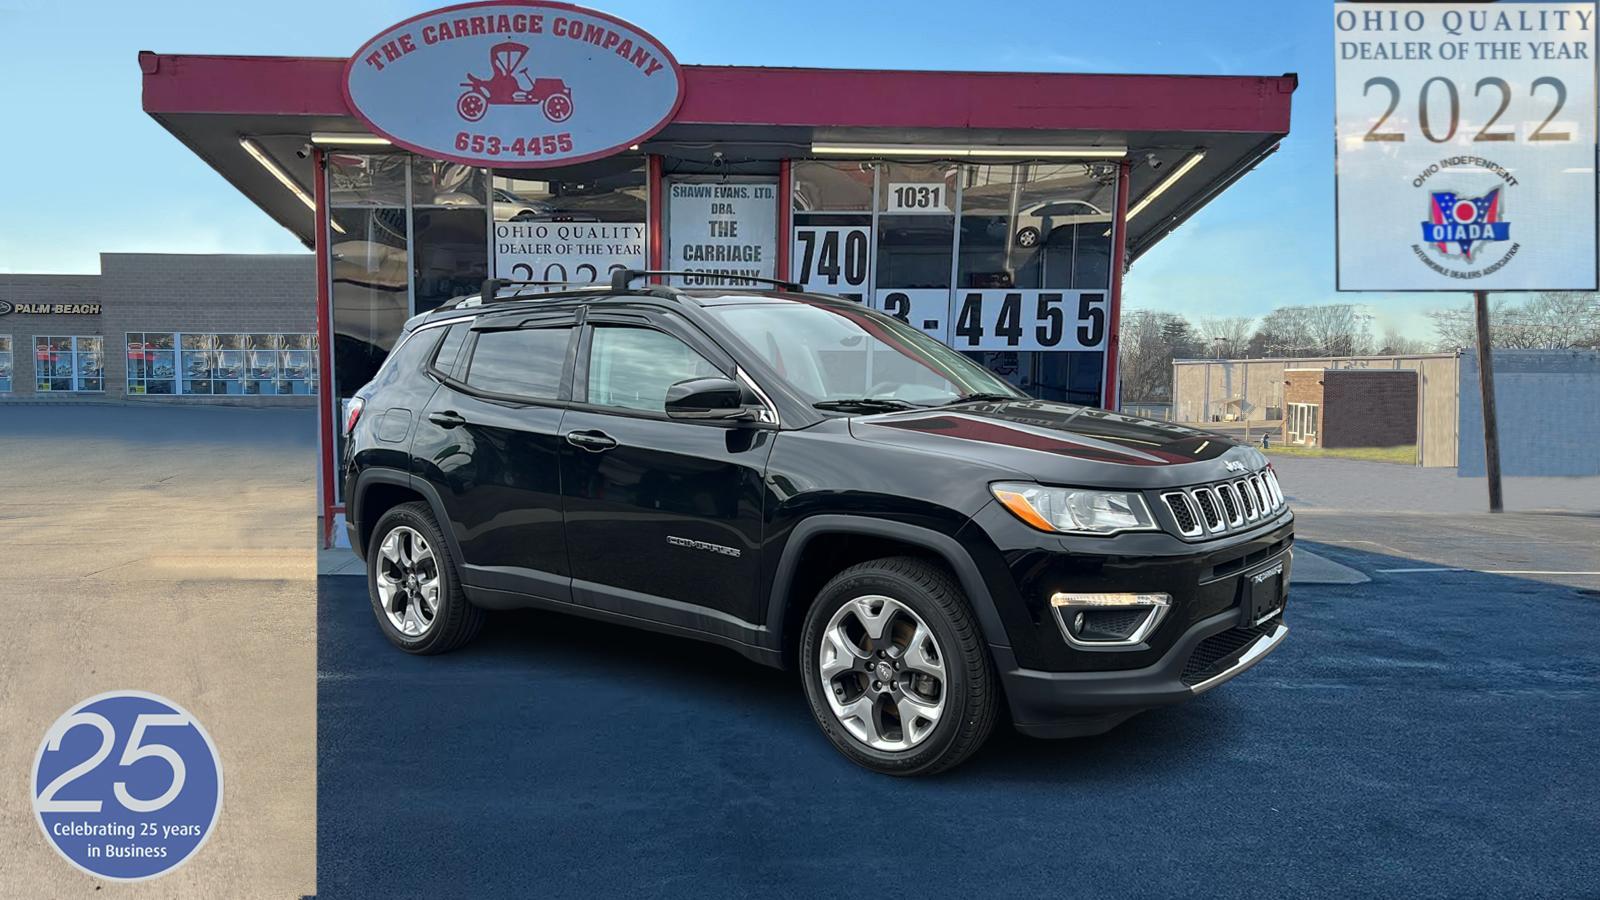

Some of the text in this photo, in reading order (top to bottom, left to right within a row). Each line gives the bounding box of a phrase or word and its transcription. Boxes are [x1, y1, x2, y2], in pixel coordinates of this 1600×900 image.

[1336, 10, 1592, 36] OHIO QUALITY
[365, 14, 664, 77] THE CARRIAGE COMPANY
[1340, 42, 1589, 60] DEALER OF THE YEAR
[1362, 76, 1571, 143] 2022
[455, 131, 573, 157] 653-4455
[1412, 155, 1519, 188] OHIO INDEPENDENT
[673, 186, 711, 198] SHAWN
[754, 187, 775, 199] LTD.
[894, 187, 940, 208] 1031
[711, 203, 736, 215] DBA.
[497, 226, 644, 241] OHIO QUALITY
[708, 220, 738, 237] THE
[1432, 224, 1495, 240] OIADA
[500, 243, 641, 255] DEALER OF THE YEAR
[683, 244, 762, 262] CARRIAGE
[797, 230, 868, 286] 740
[1411, 242, 1521, 280] AUTOMOBILE DEALERS ASSOCIATION
[683, 268, 760, 286] COMPANY
[14, 303, 100, 314] PALM BEACH
[666, 535, 740, 558] COMPASS
